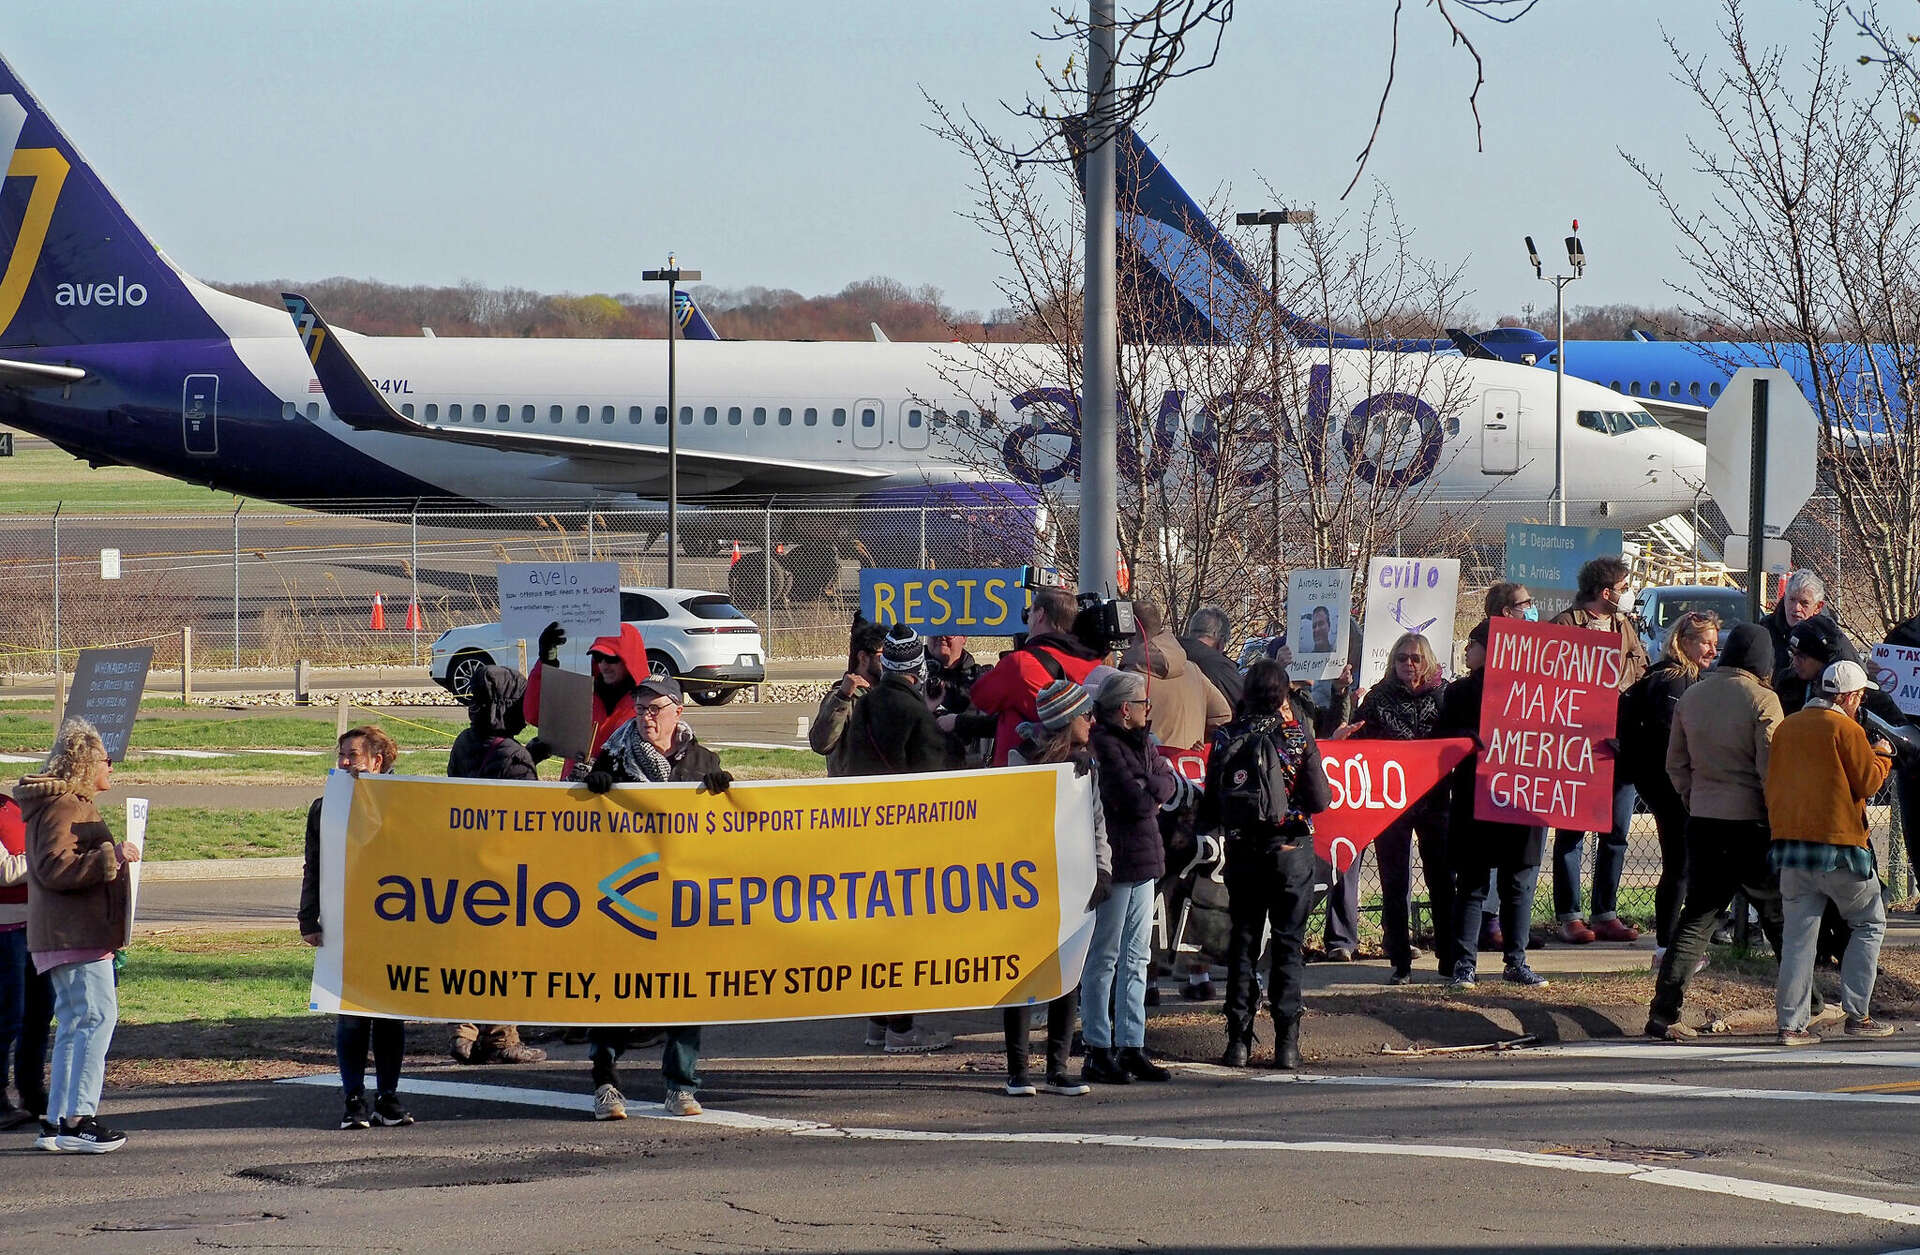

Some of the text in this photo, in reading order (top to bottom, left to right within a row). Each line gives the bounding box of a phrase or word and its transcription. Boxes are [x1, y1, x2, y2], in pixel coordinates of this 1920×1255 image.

[56, 275, 148, 306] avelo
[1002, 364, 1444, 487] avelo
[1530, 532, 1575, 551] Departures
[529, 565, 578, 586] avelo
[1530, 563, 1561, 580] Arrivals
[1491, 632, 1621, 689] IMMIGRANTS
[1876, 647, 1890, 658] NO
[1503, 680, 1587, 728] MAKE
[1485, 728, 1595, 774] AMERICA
[1321, 753, 1407, 810] SÓLO
[1490, 771, 1587, 818] GREAT
[449, 799, 978, 835] DON'T LET YOUR VACATION $ SUPPORT FAMILY SEPARATION
[374, 860, 1039, 929] avelo DEPORTATIONS
[386, 954, 1020, 1003] WE WON'T FLY, UNTIL THEY STOP ICE FLIGHTS
